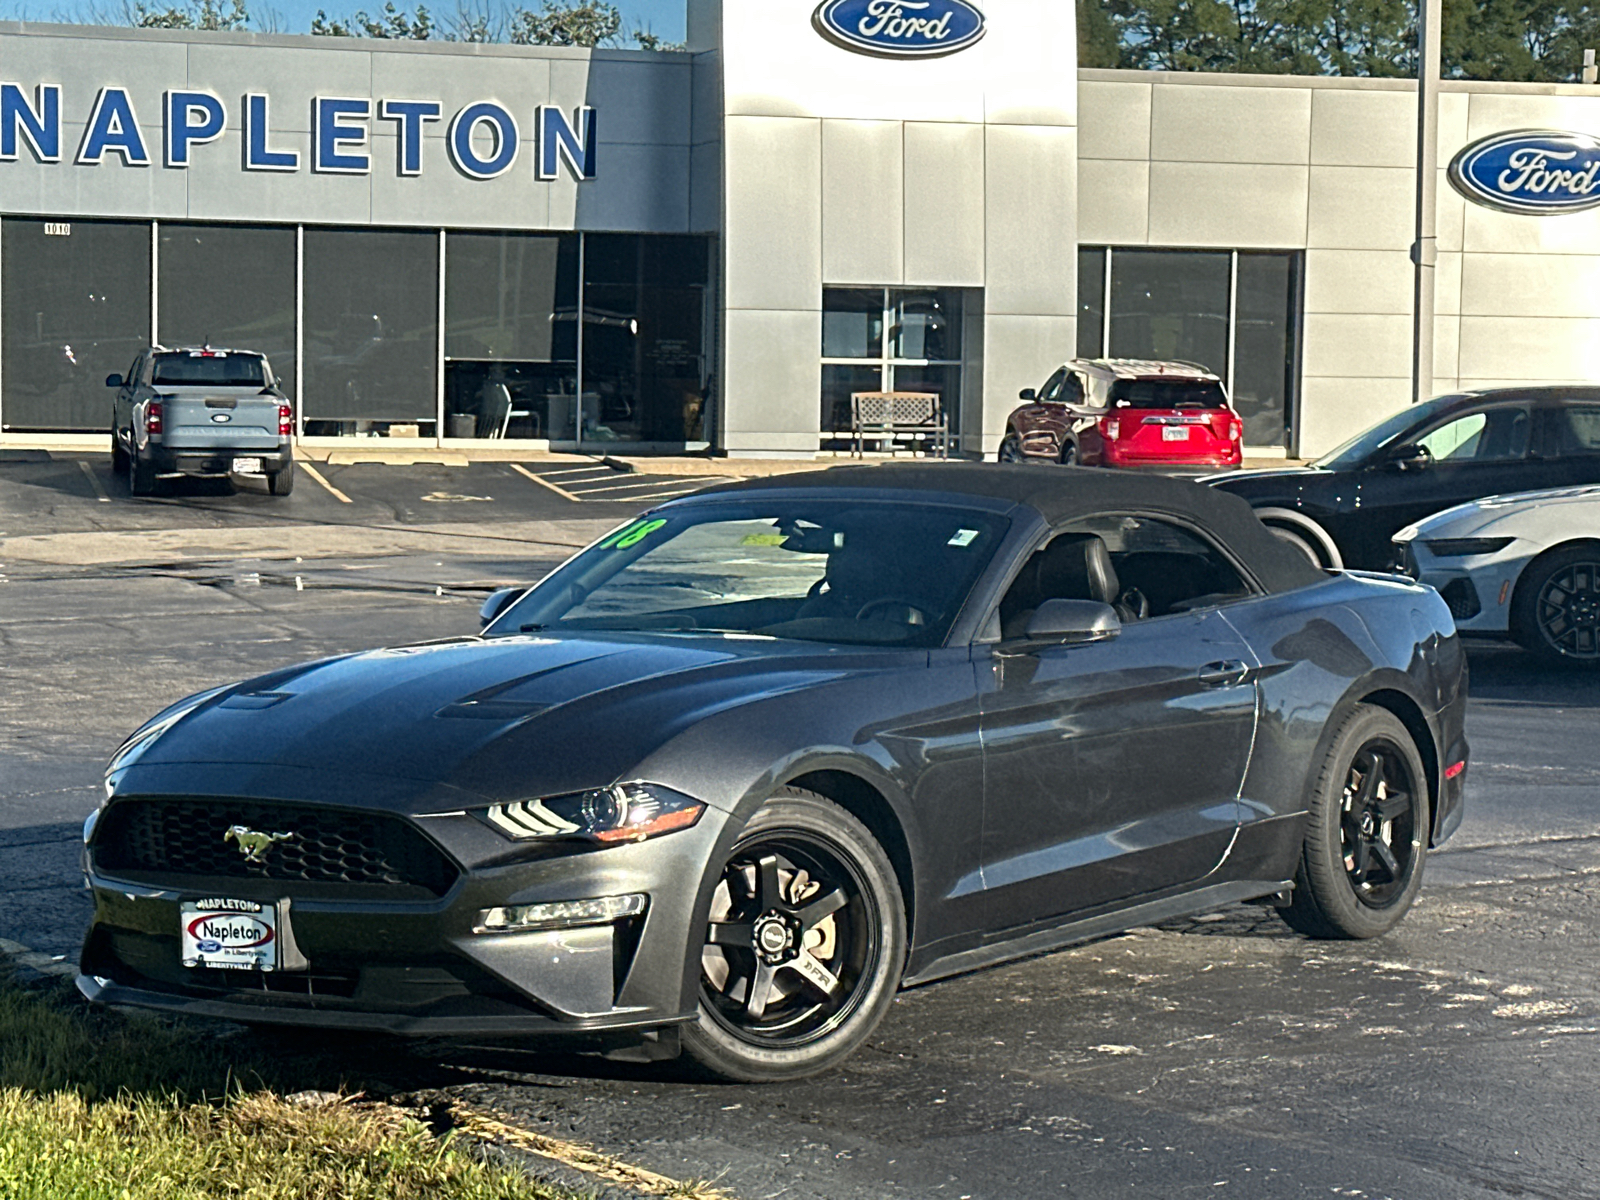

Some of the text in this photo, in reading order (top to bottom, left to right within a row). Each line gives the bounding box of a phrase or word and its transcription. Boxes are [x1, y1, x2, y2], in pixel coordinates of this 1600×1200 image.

[858, 0, 953, 39] Ford
[0, 82, 597, 180] NAPLETON
[1498, 147, 1600, 195] Ford
[47, 224, 69, 234] 1010
[600, 518, 667, 549] 18
[202, 899, 256, 911] NAPLETON
[203, 922, 261, 942] Napleton
[206, 961, 252, 970] LIBERTYVILLE
